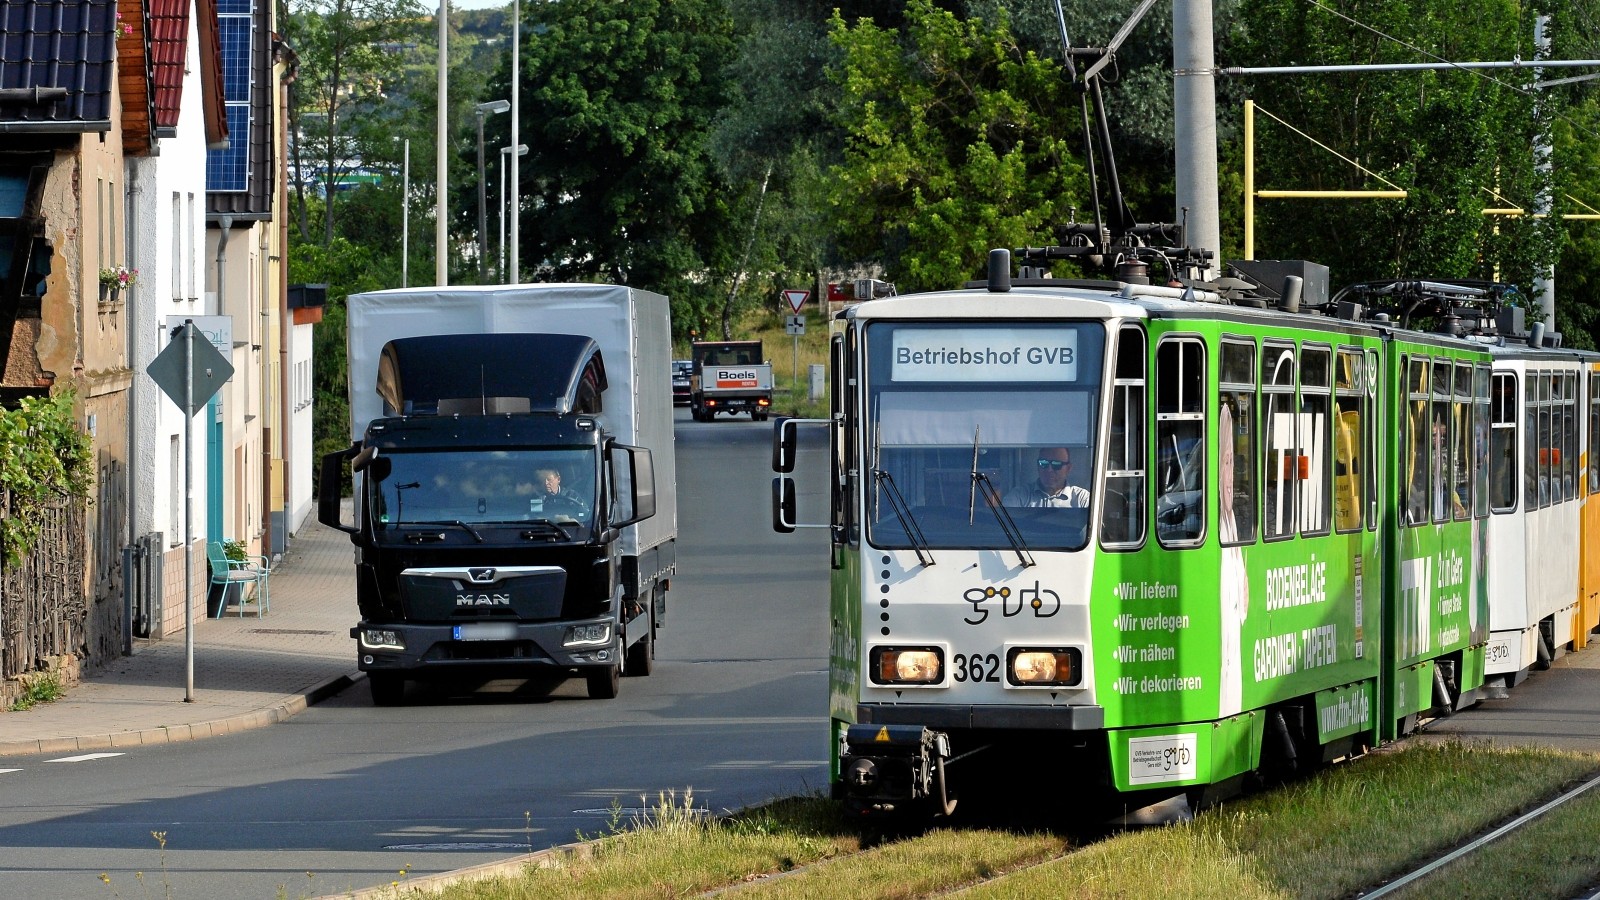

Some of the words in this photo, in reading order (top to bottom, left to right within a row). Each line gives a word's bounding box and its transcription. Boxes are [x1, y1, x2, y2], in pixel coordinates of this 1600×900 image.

[896, 347, 1021, 366] Betriebshof
[1026, 347, 1074, 366] GVB
[718, 371, 756, 380] Boels
[1140, 581, 1178, 599] liefern
[1266, 553, 1326, 612] BODENBELÄGE
[456, 593, 510, 606] MAN
[963, 580, 1061, 626] gvb
[1140, 612, 1190, 633] verlegen
[1140, 643, 1175, 662] nähen
[1253, 631, 1297, 683] GARDINEN
[1302, 623, 1337, 671] TAPETEN
[953, 653, 1000, 683] 362
[1140, 674, 1202, 694] dekorieren
